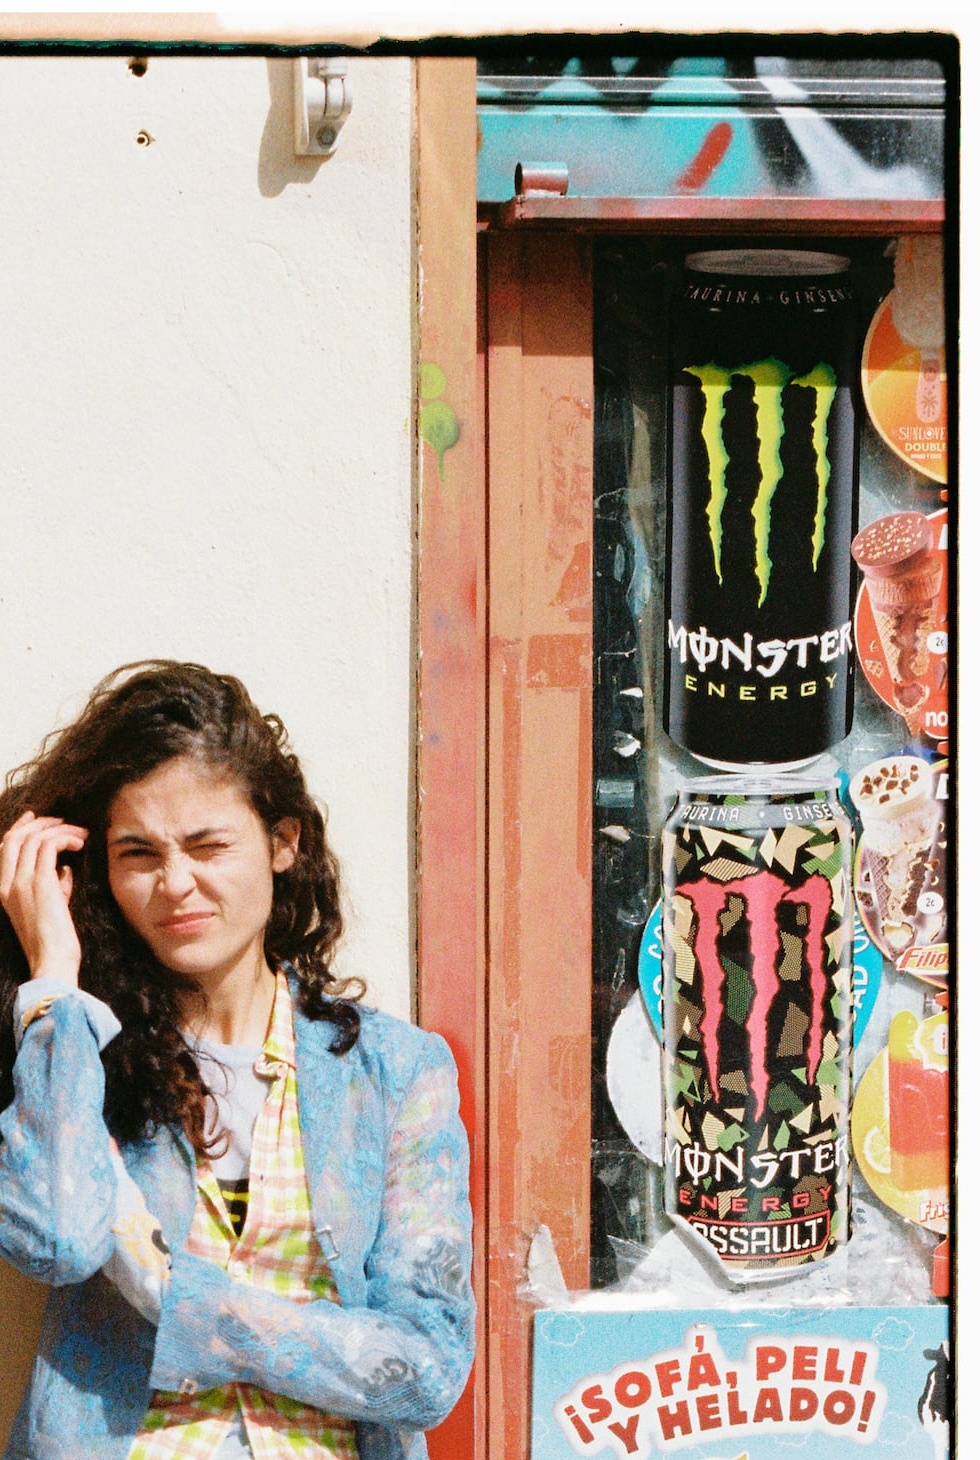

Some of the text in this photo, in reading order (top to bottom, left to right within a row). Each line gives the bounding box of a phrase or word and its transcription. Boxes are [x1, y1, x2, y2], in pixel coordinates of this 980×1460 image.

[684, 673, 838, 700] ENERGY
[679, 1185, 832, 1213] ENERGY
[564, 1335, 867, 1444] ¡SOFÁ, PELI
[608, 1387, 876, 1454] Y HELADO!
